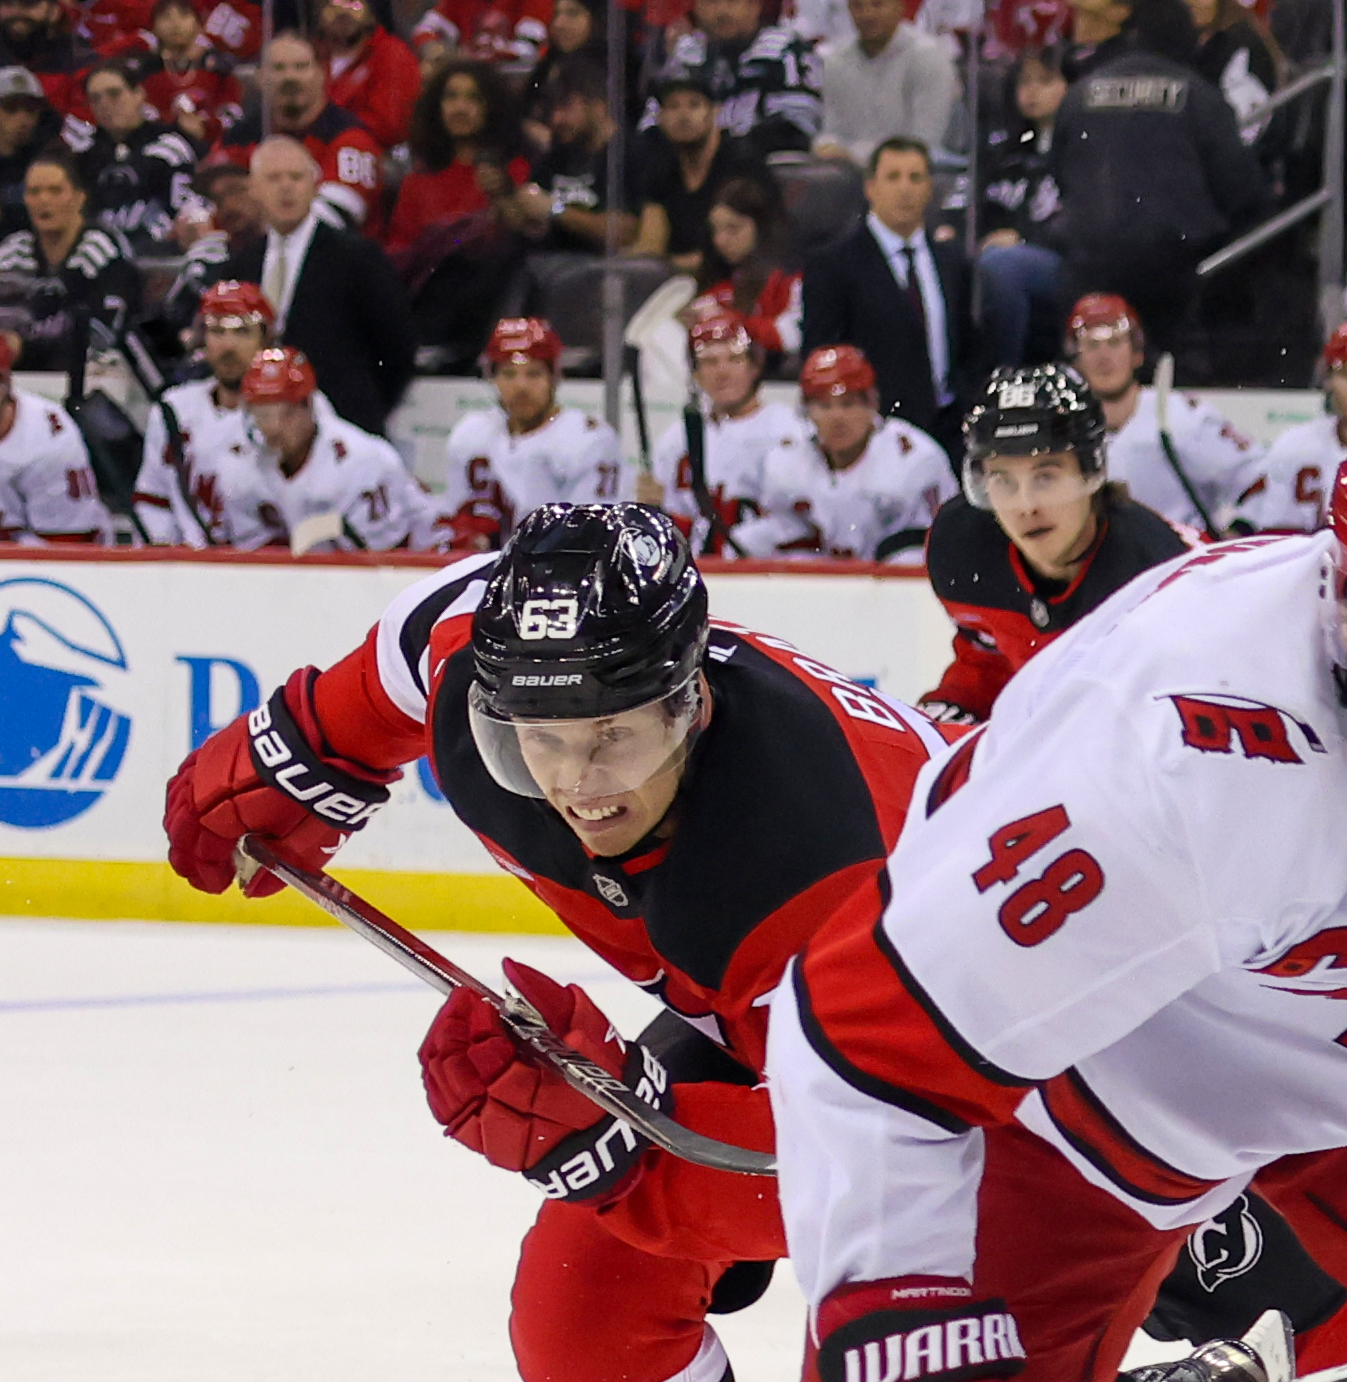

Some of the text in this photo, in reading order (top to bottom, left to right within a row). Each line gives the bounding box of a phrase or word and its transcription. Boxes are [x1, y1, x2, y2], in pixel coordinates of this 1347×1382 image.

[519, 599, 579, 640] 63
[512, 674, 583, 686] BAUER
[248, 701, 385, 826] BAUER
[971, 803, 1105, 948] 48
